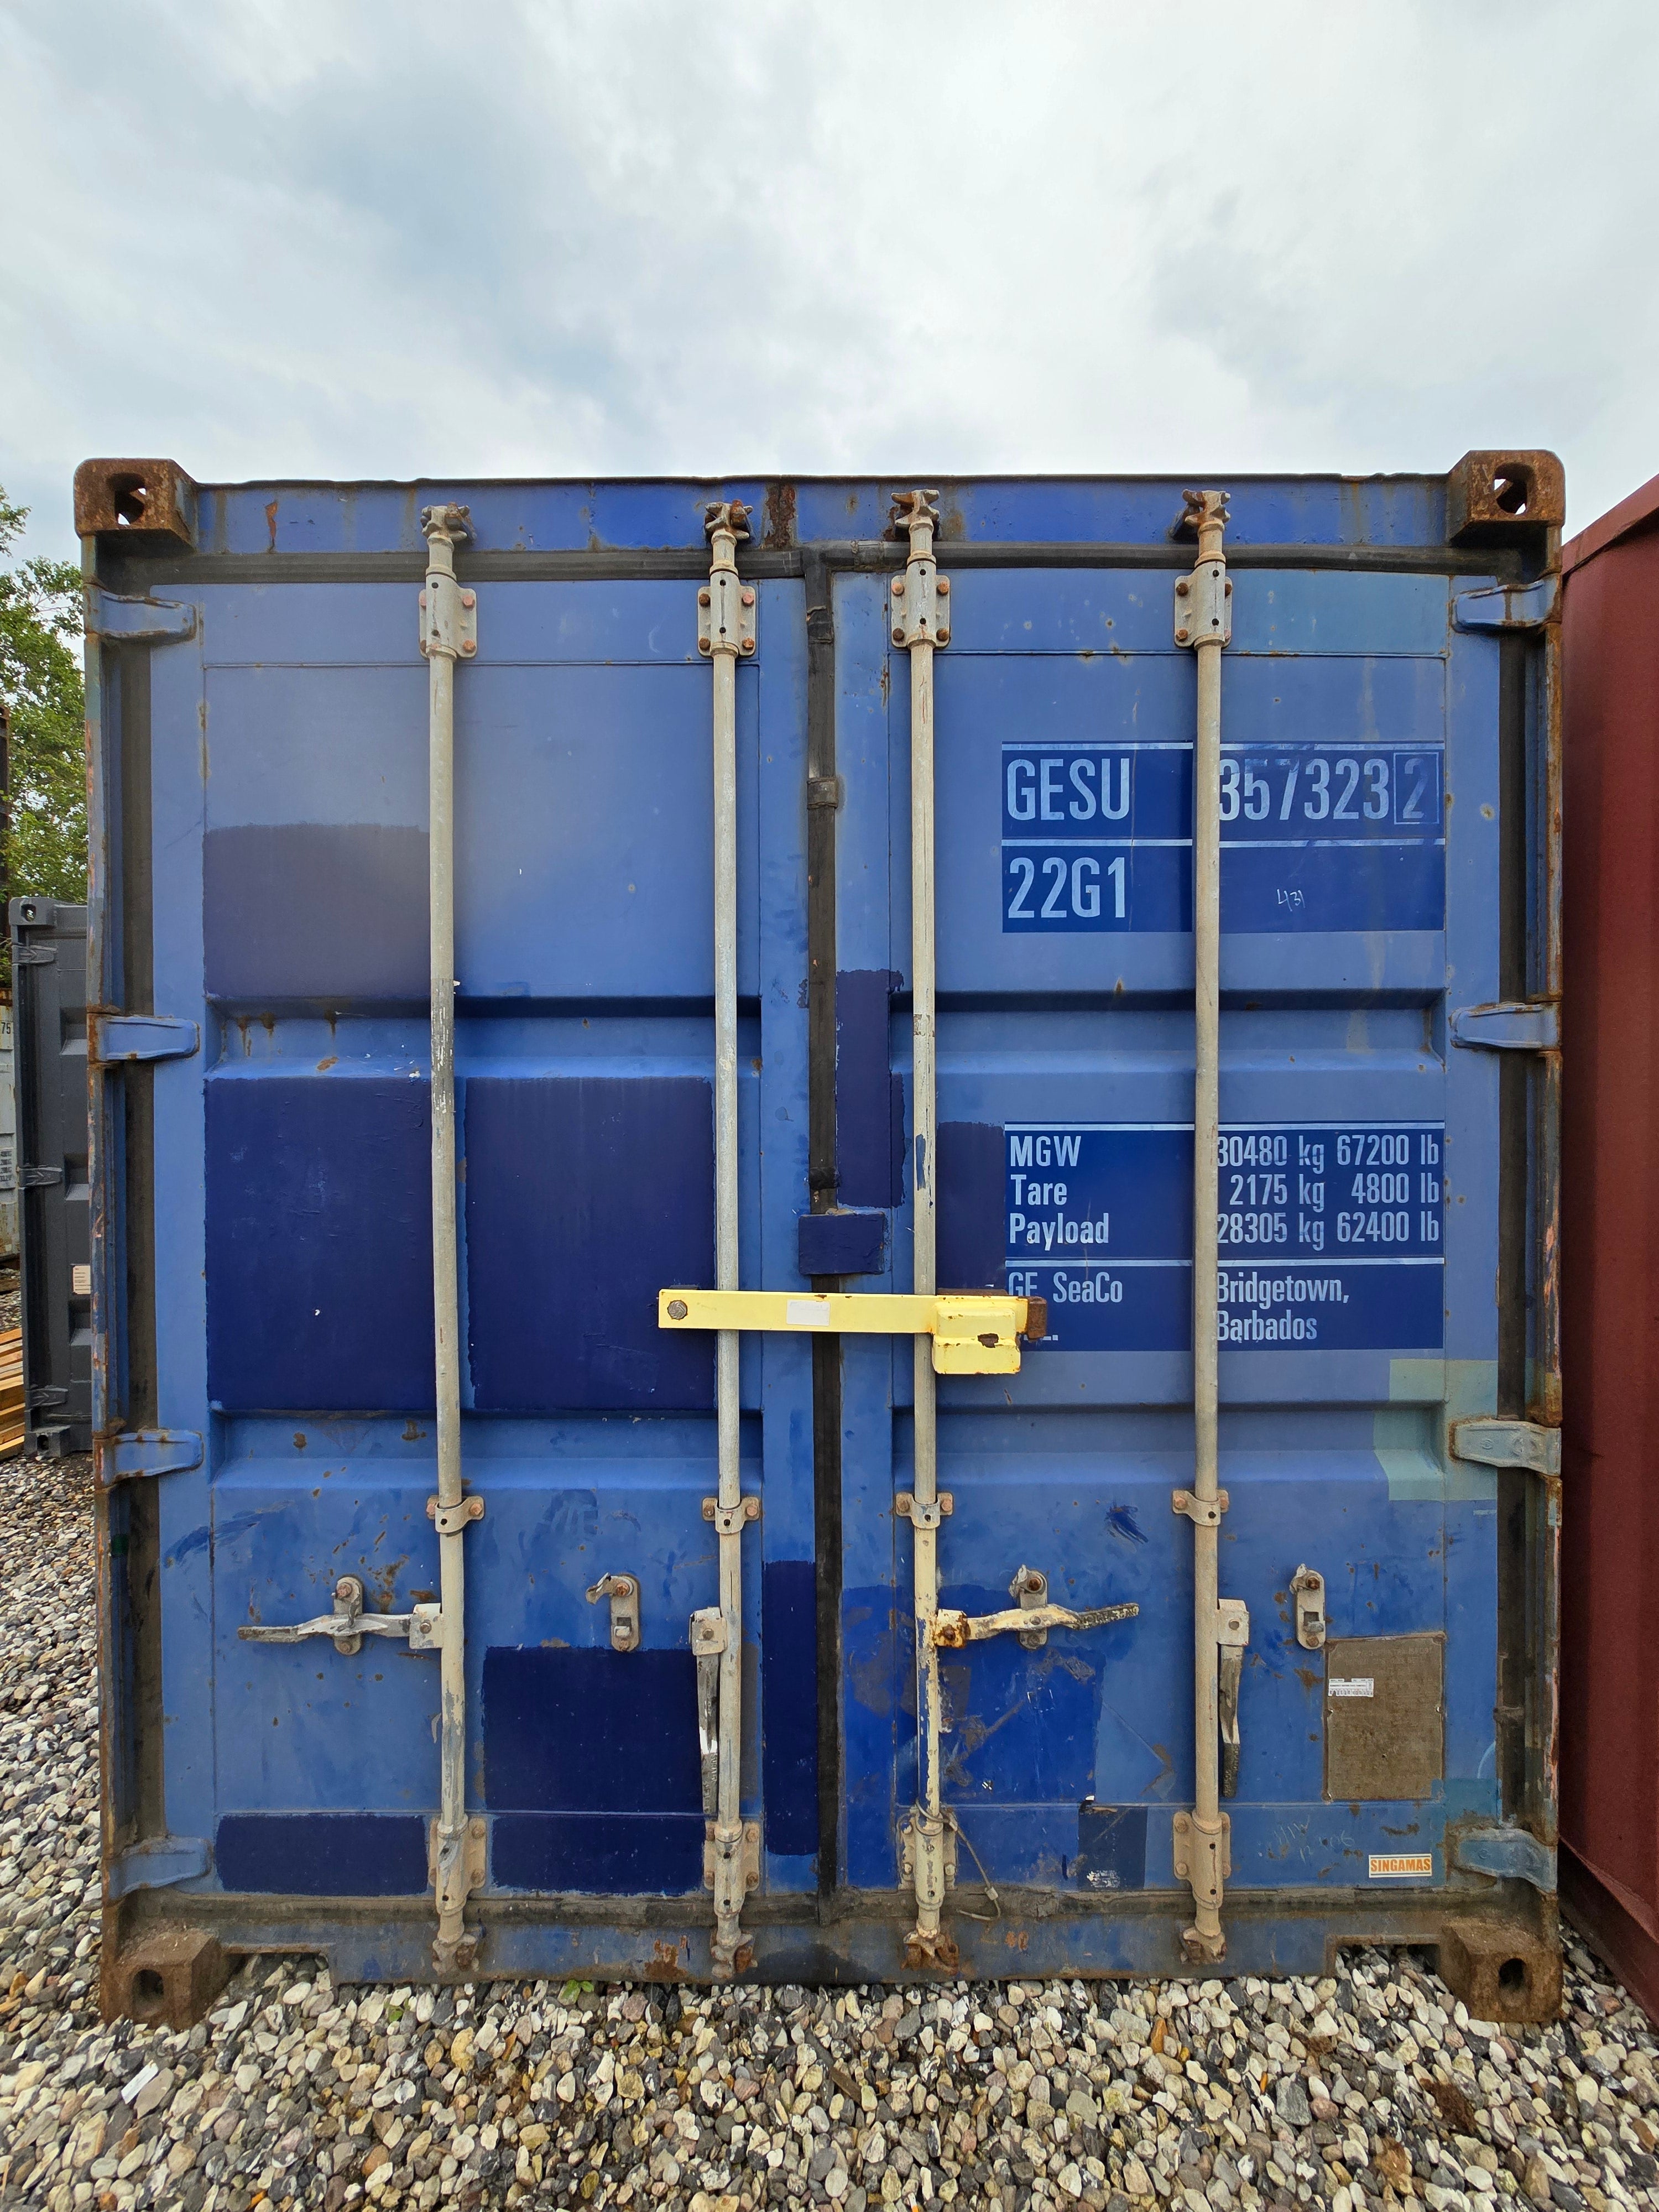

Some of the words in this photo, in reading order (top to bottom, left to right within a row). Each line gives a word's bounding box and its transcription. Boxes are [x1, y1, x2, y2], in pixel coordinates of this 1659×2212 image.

[1008, 758, 1129, 820] GESU
[1219, 758, 1389, 820] 357323
[1402, 758, 1428, 818] 2
[1009, 857, 1125, 918] 22G1
[1011, 1136, 1081, 1166] MGW
[1218, 1136, 1287, 1166] 30480
[1299, 1135, 1324, 1175] kg
[1337, 1135, 1408, 1165] 67200
[1421, 1135, 1438, 1165] lb
[1011, 1175, 1067, 1205] Tare
[1230, 1175, 1287, 1204] 2175
[1299, 1173, 1324, 1213] kg
[1352, 1173, 1408, 1203] 4800
[1421, 1173, 1438, 1203] lb
[1010, 1213, 1108, 1250] Payload
[1218, 1213, 1287, 1243] 28305
[1300, 1212, 1324, 1251] kg
[1338, 1212, 1408, 1241] 62400
[1421, 1211, 1438, 1241] lb
[1053, 1272, 1122, 1302] SeaCo
[1218, 1272, 1349, 1310] Bridgetown,
[1218, 1310, 1317, 1343] Barbados
[1370, 1858, 1431, 1871] SINGAMAS
